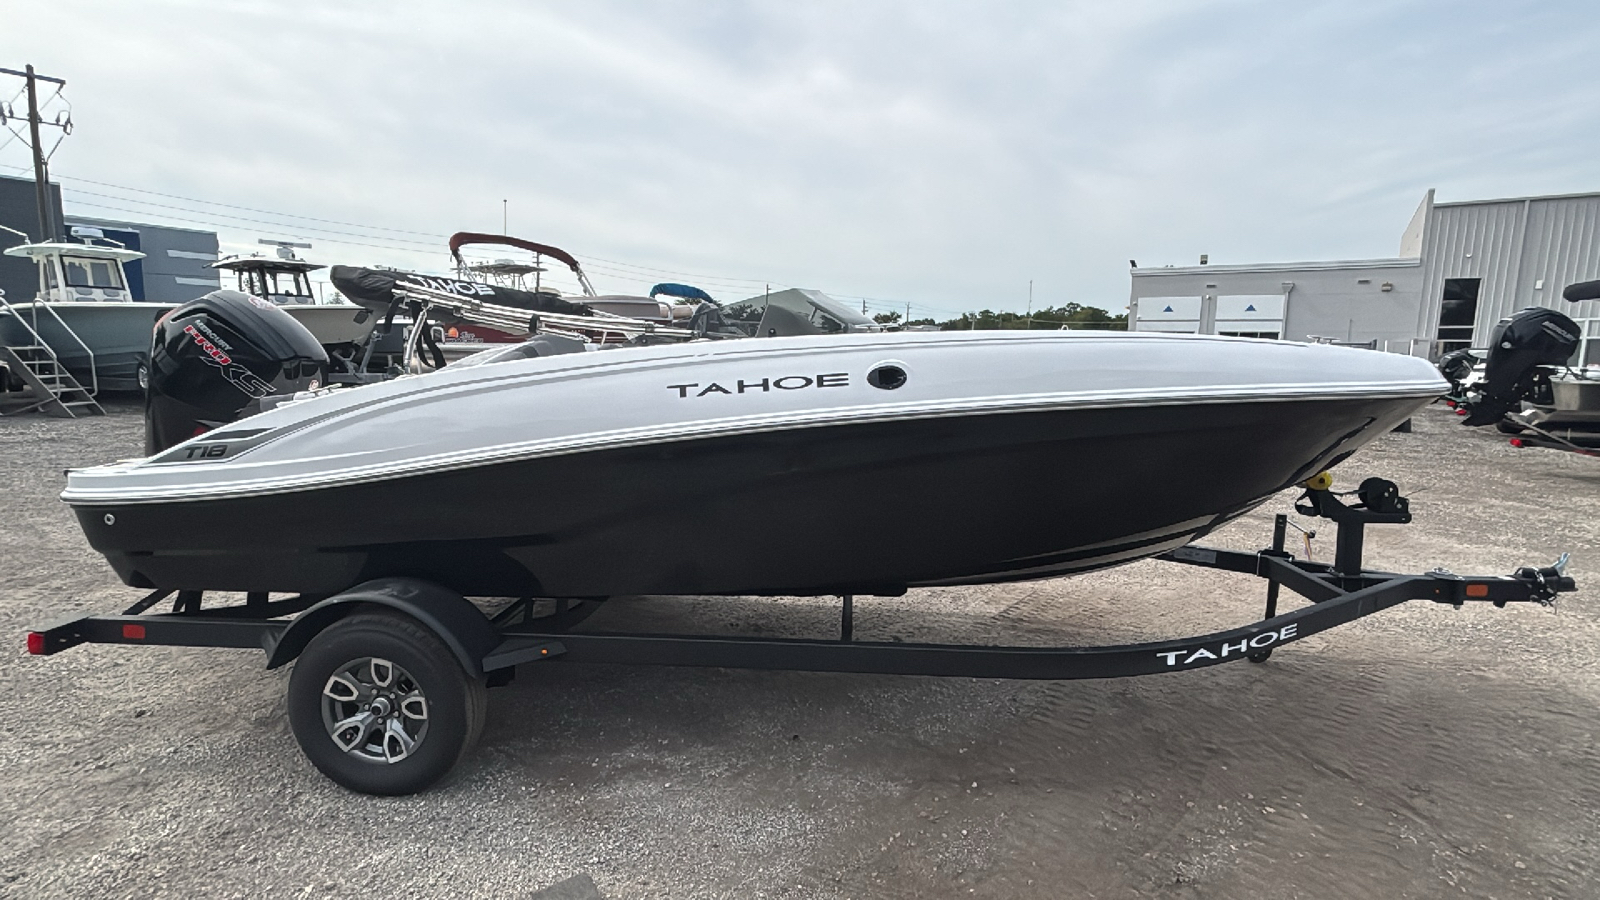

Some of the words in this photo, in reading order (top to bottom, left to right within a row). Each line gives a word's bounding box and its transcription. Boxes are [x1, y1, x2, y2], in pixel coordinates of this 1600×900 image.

[407, 274, 496, 296] TAHOE
[183, 324, 232, 366] PRO
[194, 319, 234, 351] MERCURY
[666, 372, 850, 399] TAHOE
[184, 444, 229, 459] T18
[1156, 622, 1298, 666] TAHOE
